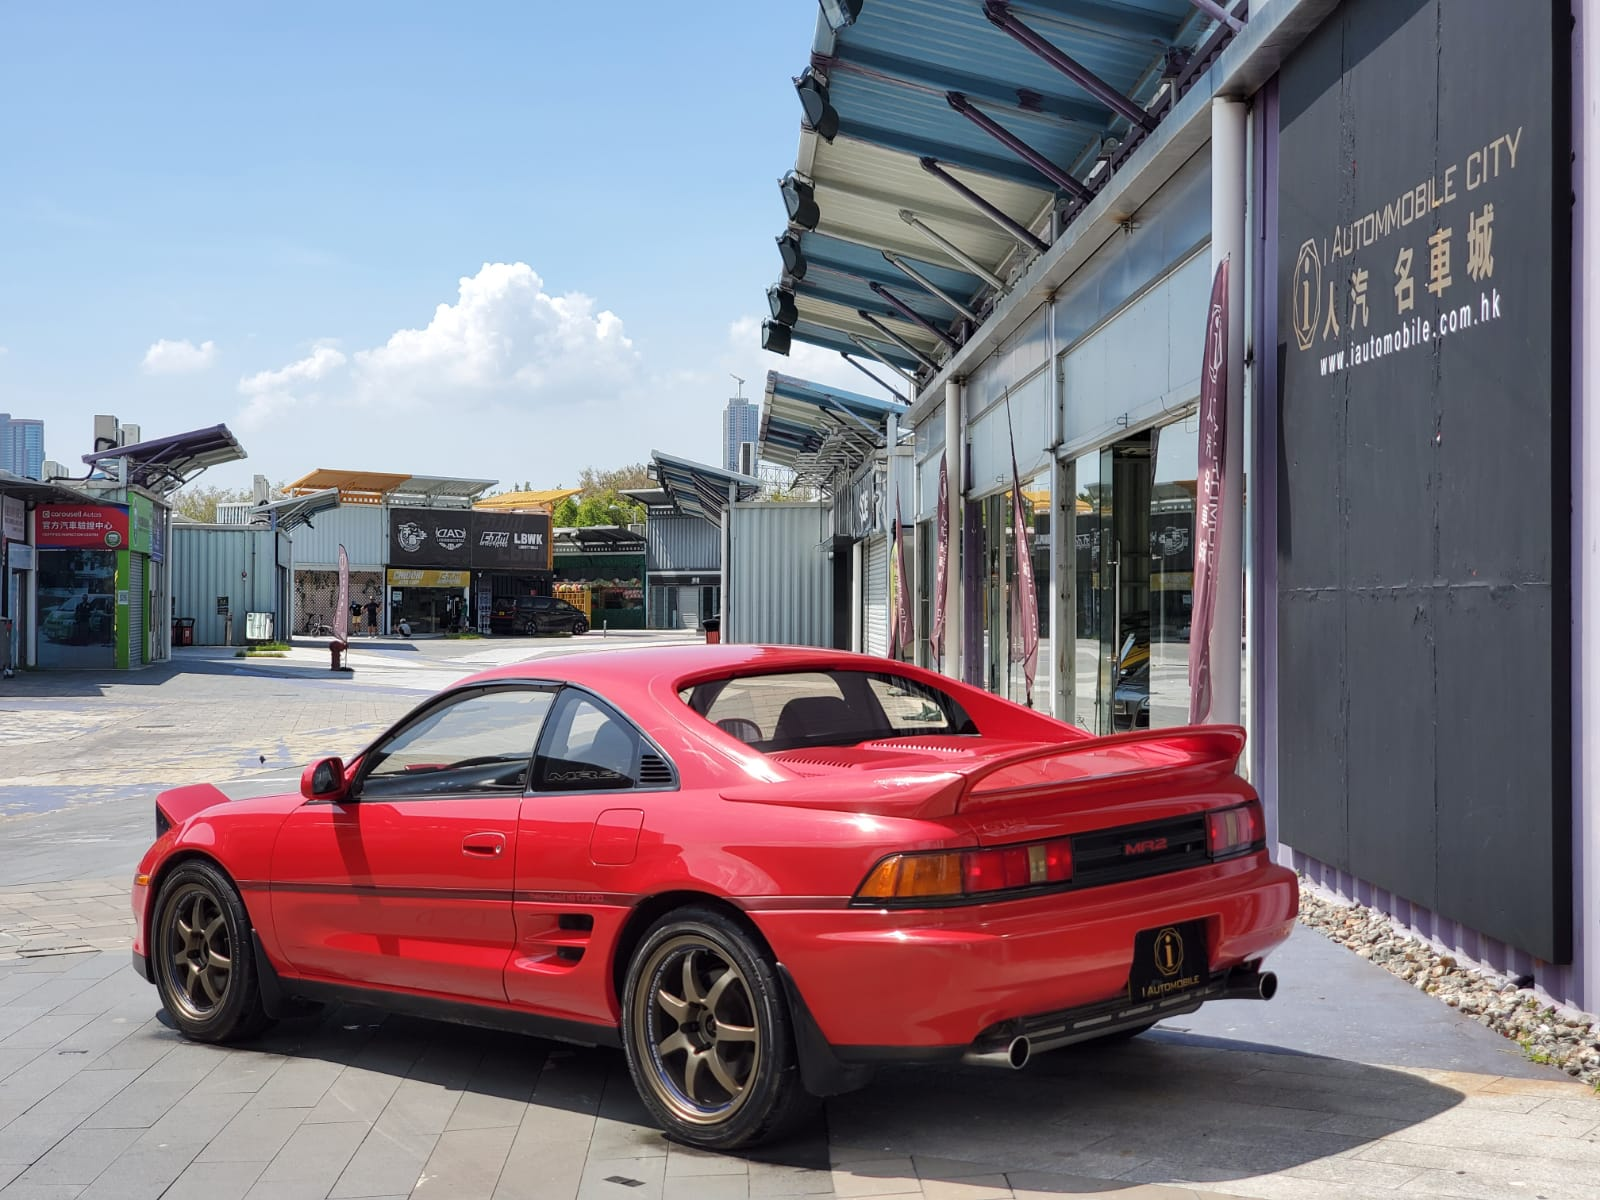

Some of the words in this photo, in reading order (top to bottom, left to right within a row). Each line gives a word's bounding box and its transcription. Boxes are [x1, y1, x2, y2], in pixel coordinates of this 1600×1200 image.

[1331, 165, 1457, 263] AUTOMMOBILE
[1466, 126, 1522, 191] CITY
[1320, 288, 1501, 376] www.iautomobile.com.hk
[51, 510, 82, 518] carousell
[514, 533, 543, 545] LBWK
[1125, 837, 1168, 855] MR2
[1147, 975, 1200, 997] AUTOMOBILE
